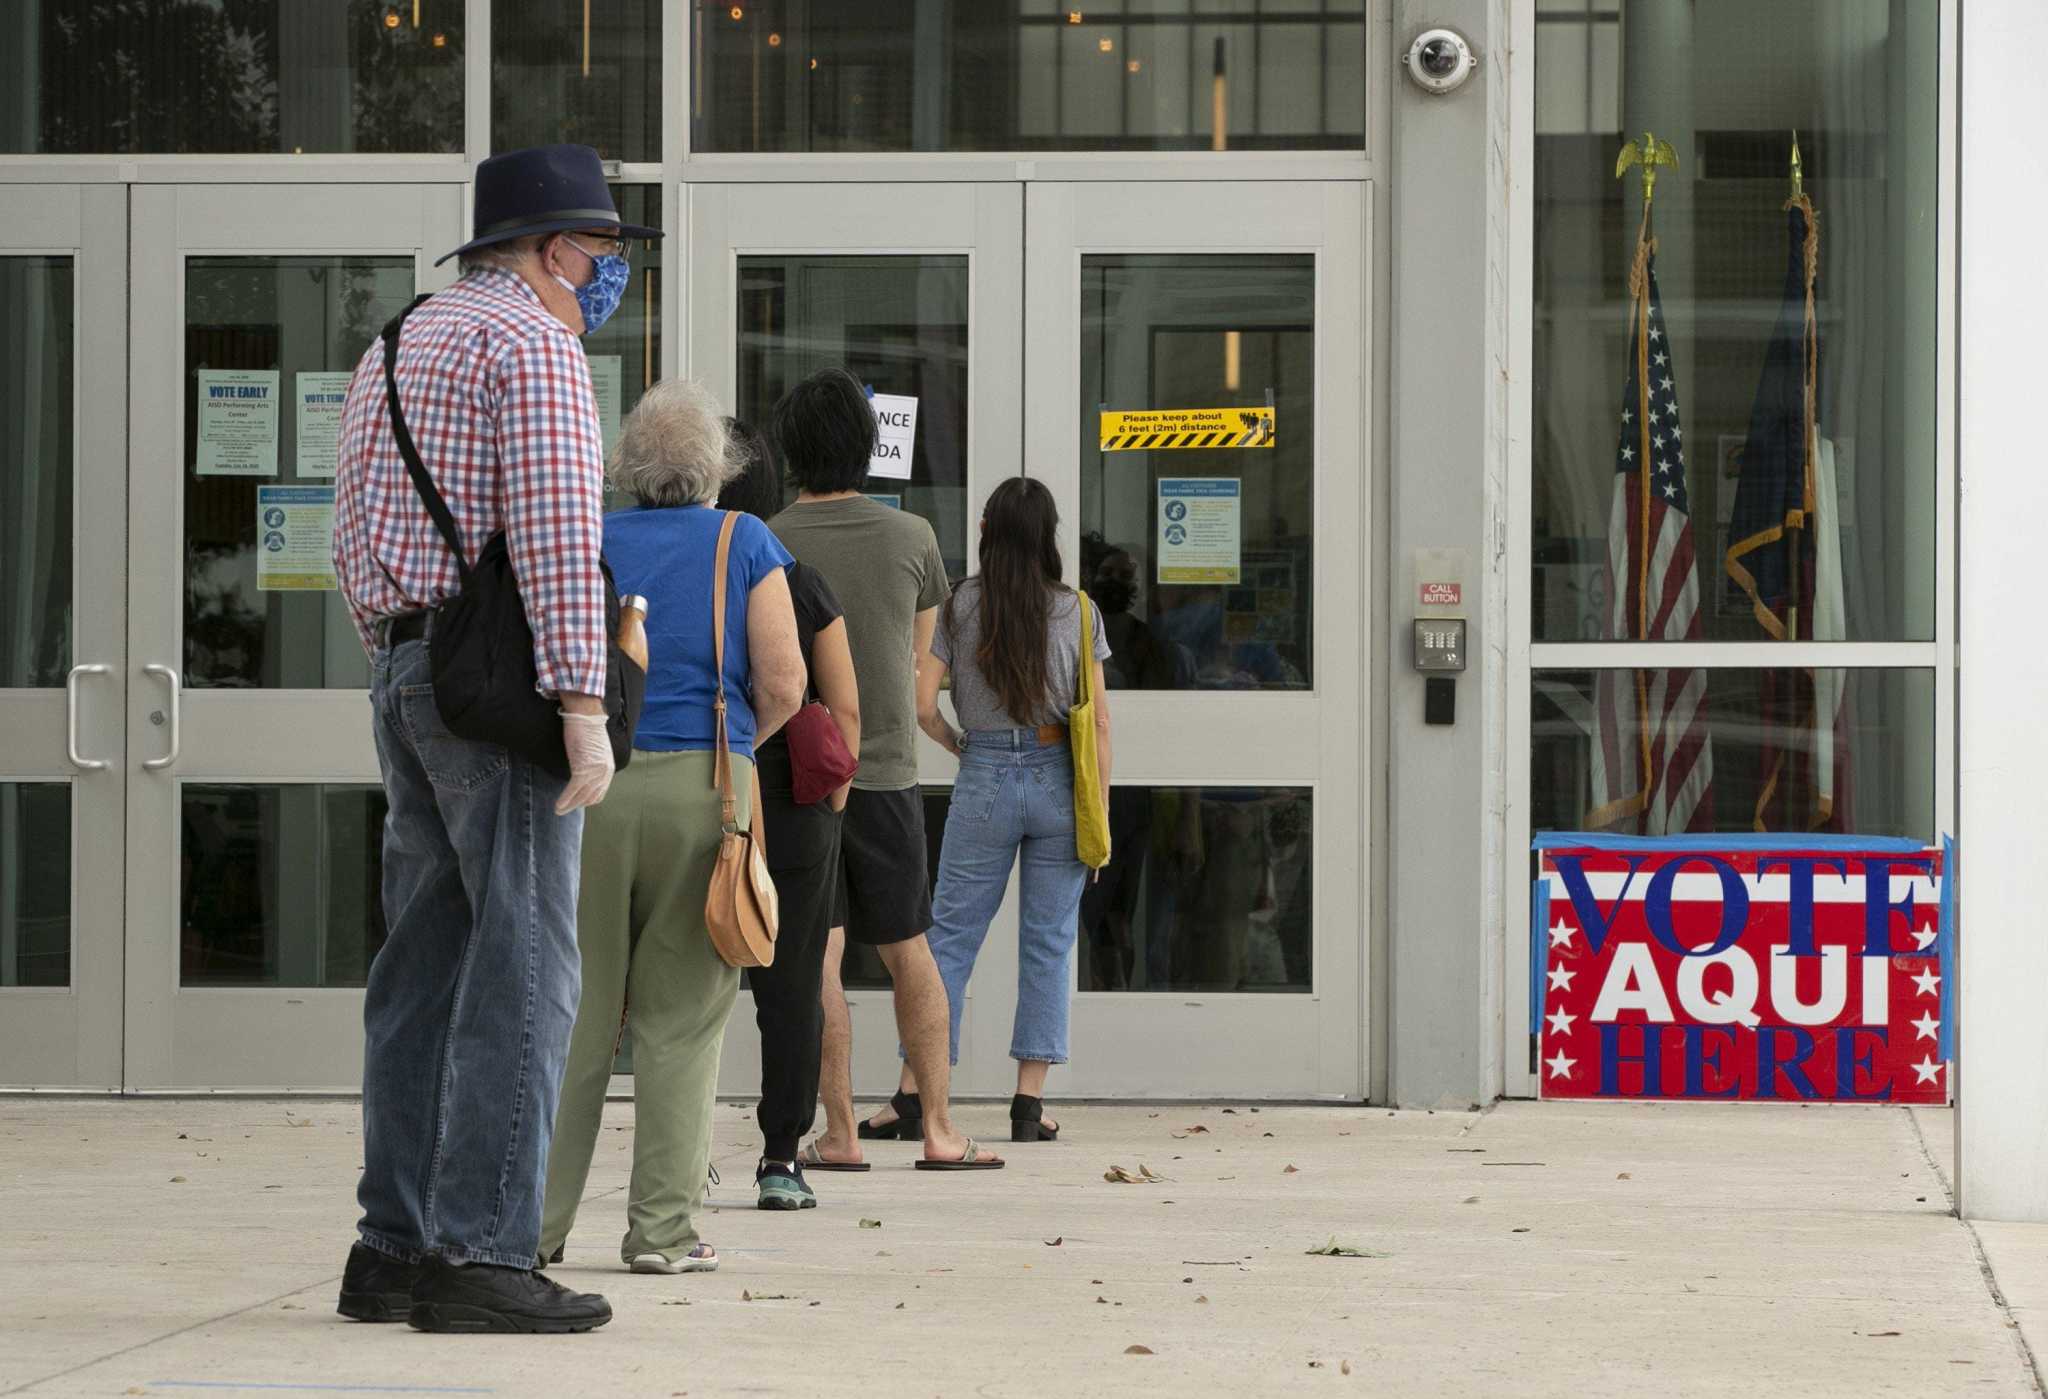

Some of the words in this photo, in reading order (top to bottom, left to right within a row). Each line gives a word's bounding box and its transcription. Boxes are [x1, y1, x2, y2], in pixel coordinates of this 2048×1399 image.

[209, 386, 236, 398] VOTE
[238, 386, 268, 398] EARLY
[304, 394, 325, 403] VOTE
[1153, 424, 1177, 432] (2m)
[1180, 423, 1227, 431] distance
[1429, 584, 1452, 593] CALL
[1424, 593, 1458, 602] BUTTON
[1546, 854, 1938, 958] VOTE
[1589, 942, 1889, 1031] AQUI
[1592, 1023, 1894, 1100] HERE
